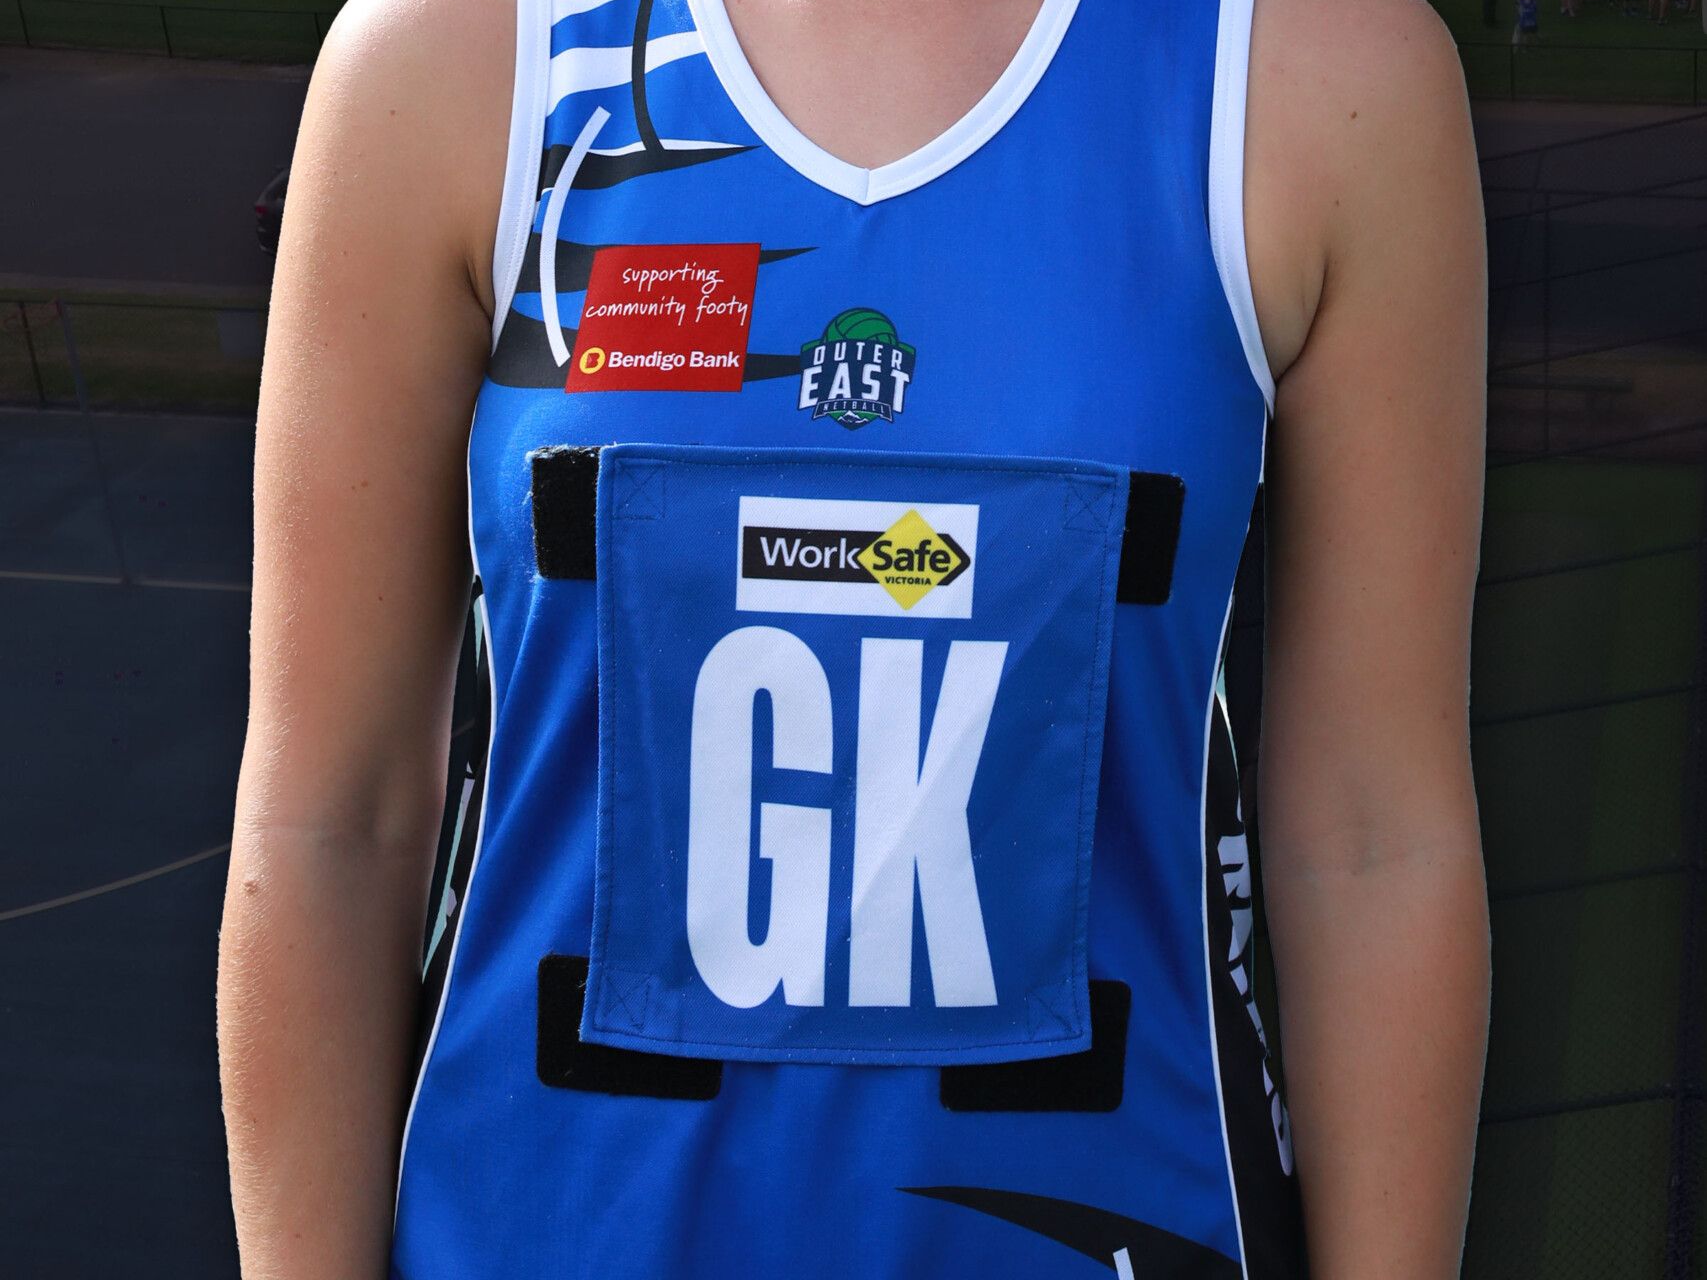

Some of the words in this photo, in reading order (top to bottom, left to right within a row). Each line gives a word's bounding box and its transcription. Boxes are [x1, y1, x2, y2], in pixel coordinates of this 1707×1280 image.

[622, 262, 724, 295] supporting
[585, 296, 686, 326] community
[695, 295, 748, 326] footy
[608, 351, 686, 371] Bendigo
[689, 351, 740, 368] Bank
[813, 342, 903, 371] OUTER
[798, 362, 910, 413] EAST
[822, 401, 885, 414] NETBALL
[884, 575, 932, 586] VICTORIA
[686, 625, 1010, 1009] GK
